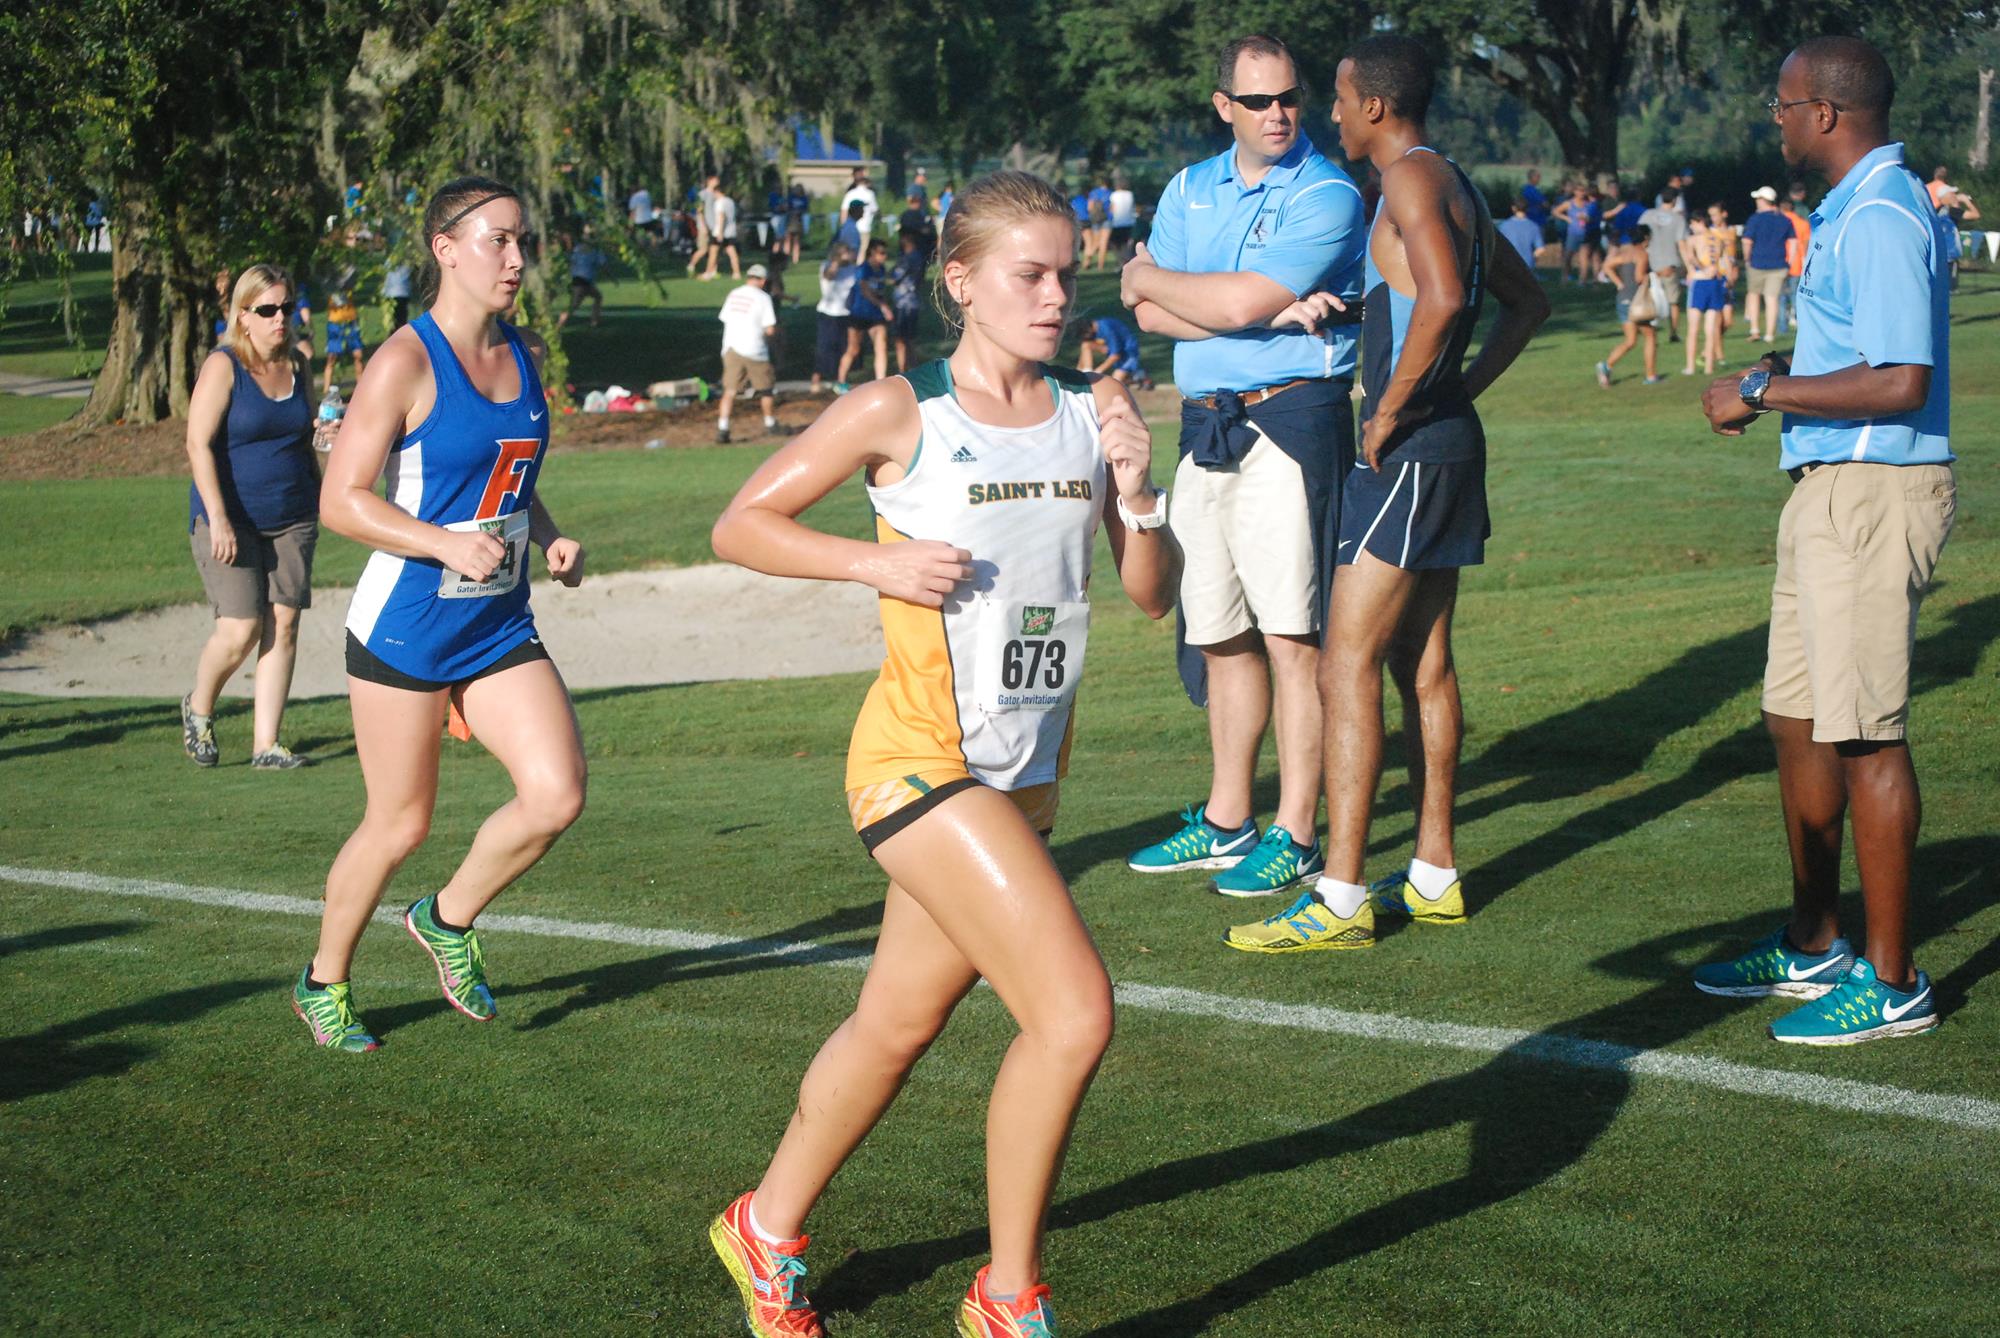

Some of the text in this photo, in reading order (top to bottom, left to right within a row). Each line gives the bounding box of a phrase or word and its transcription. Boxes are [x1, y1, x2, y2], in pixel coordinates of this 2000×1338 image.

[950, 455, 978, 463] adidas
[473, 438, 542, 521] F
[967, 479, 1093, 505] SAINT LEO
[456, 585, 477, 593] Gator
[1001, 639, 1067, 690] 673
[997, 693, 1064, 705] Gator Invitational
